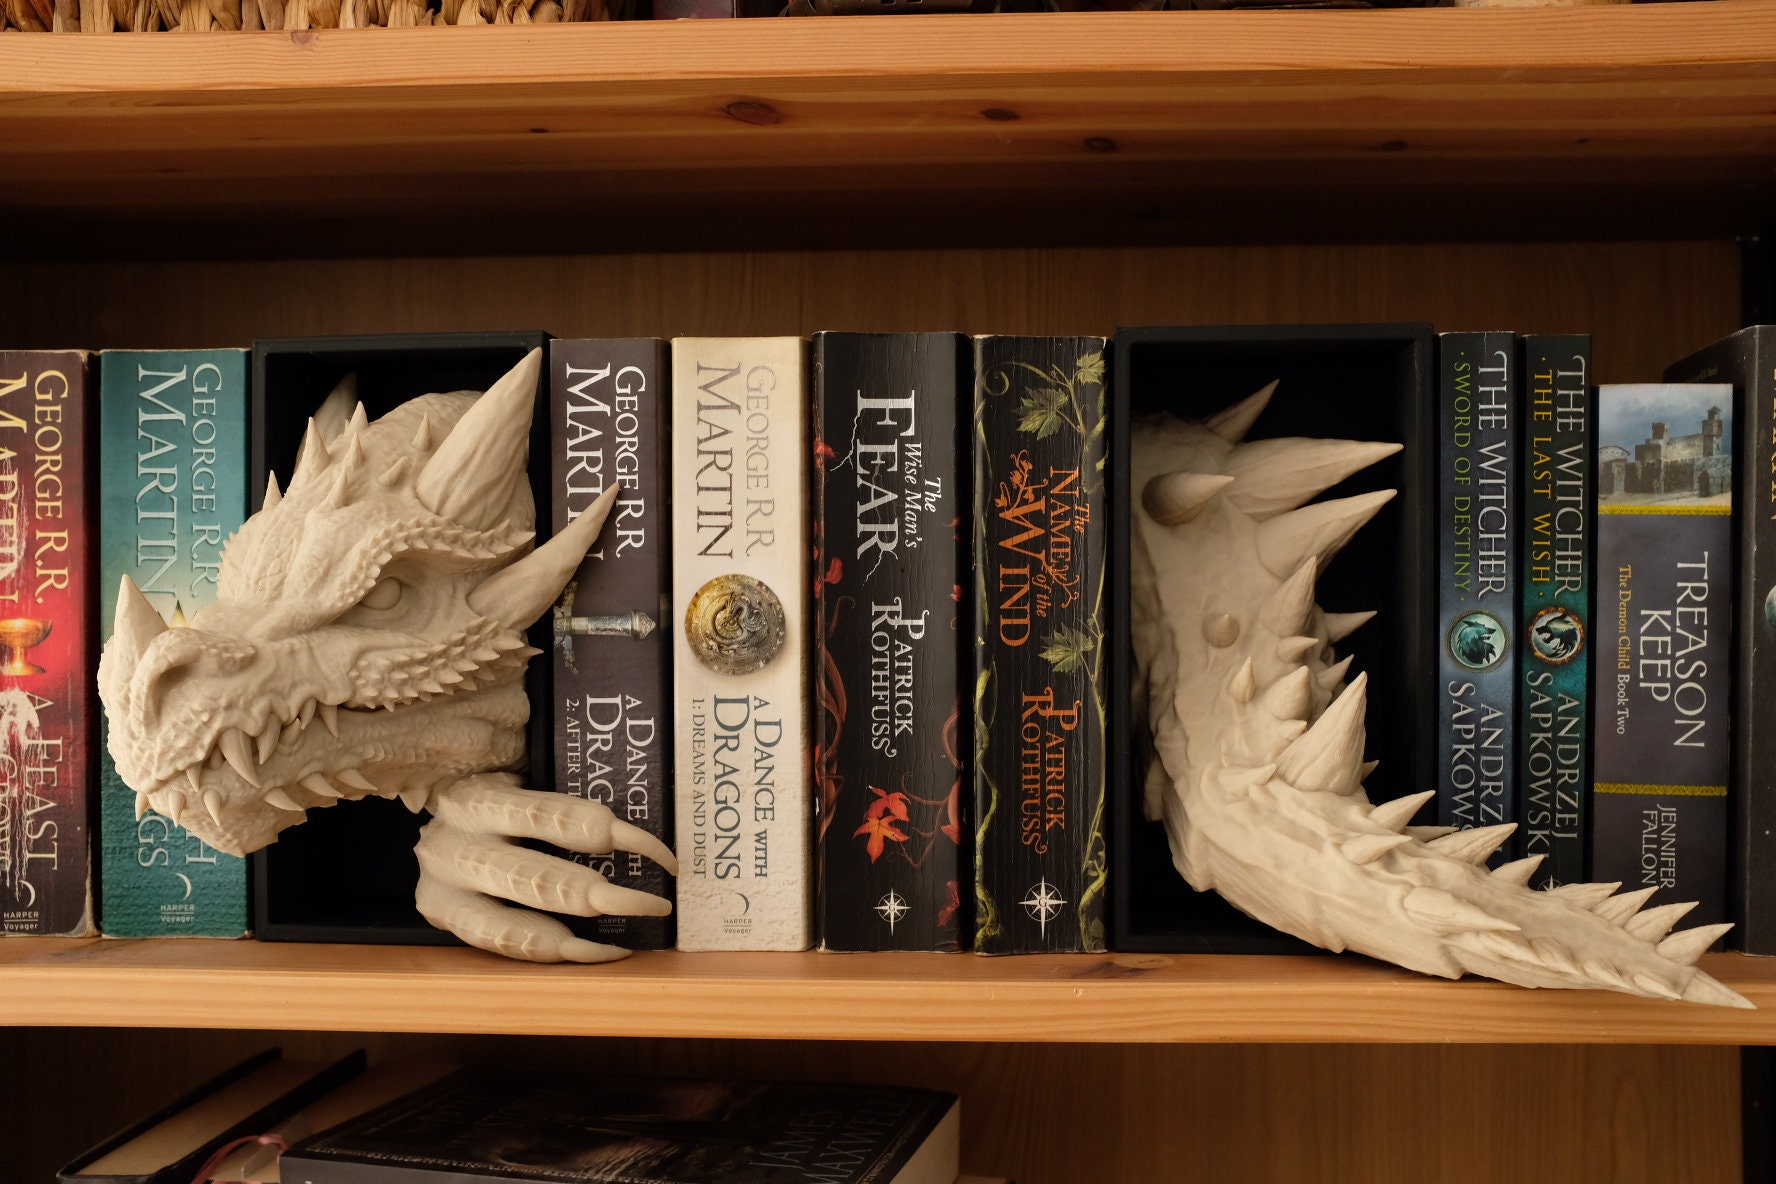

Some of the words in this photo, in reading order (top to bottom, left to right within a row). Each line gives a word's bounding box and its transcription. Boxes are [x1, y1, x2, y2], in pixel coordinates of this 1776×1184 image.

[615, 366, 646, 490] GEORGE
[746, 364, 776, 490] GEORGE
[1454, 362, 1471, 448] SWORD
[1478, 351, 1508, 430] THE
[1534, 370, 1552, 421] THE
[1556, 355, 1584, 432] THE
[34, 370, 68, 520] GEORGE
[192, 363, 222, 513] GEORGE
[566, 362, 611, 560] MART
[696, 360, 742, 560] MARTIN
[856, 389, 915, 560] FEAR
[904, 442, 922, 485] Wise
[1454, 456, 1471, 486] OF
[1533, 436, 1552, 499] LAST
[136, 364, 187, 597] MARTIN
[924, 476, 942, 513] The
[1050, 466, 1079, 564] NAME
[904, 490, 923, 549] Man's
[1074, 503, 1091, 535] The
[1454, 496, 1471, 592] DESTINY
[1478, 440, 1508, 600] WITCHER
[1532, 512, 1550, 583] WISH
[1554, 442, 1584, 600] WITCHER
[34, 528, 70, 604] R.R.
[998, 496, 1046, 647] WIND
[1032, 573, 1052, 594] of
[1619, 564, 1632, 588] The
[1036, 595, 1052, 618] the
[1618, 590, 1632, 633] Demon
[872, 596, 902, 758] ROTHFUSS
[894, 609, 930, 737] PATRICK
[1618, 636, 1631, 670] Child
[1639, 610, 1672, 702] KEEP
[1674, 551, 1708, 748] TREASON
[25, 690, 54, 711] A
[566, 698, 580, 711] 2:
[626, 695, 642, 710] A
[692, 698, 705, 710] 1:
[754, 696, 770, 711] A
[1616, 708, 1630, 735] Two
[1617, 674, 1630, 706] Book
[566, 716, 581, 775] AFTER
[626, 717, 655, 821] DANCE
[692, 714, 706, 785] DREAMS
[754, 718, 782, 822] DANCE
[1022, 686, 1054, 854] ROTHFUSS
[1045, 700, 1082, 832] PATRICK
[1480, 703, 1504, 852] ANDRZ
[1526, 670, 1553, 858] SAPKOWSKI
[1553, 692, 1580, 840] ANDRZEJ
[26, 736, 64, 871] FEAST
[693, 789, 706, 827] AND
[714, 694, 750, 880] DRAGONS
[694, 832, 706, 879] DUST
[754, 829, 768, 878] WITH
[1642, 810, 1658, 884] FALLON
[1657, 804, 1676, 889] JENNIFER
[4, 922, 38, 930] Voyager
[160, 904, 195, 912] HARPER
[160, 915, 195, 923] Voyager
[748, 1110, 844, 1171] JAMES
